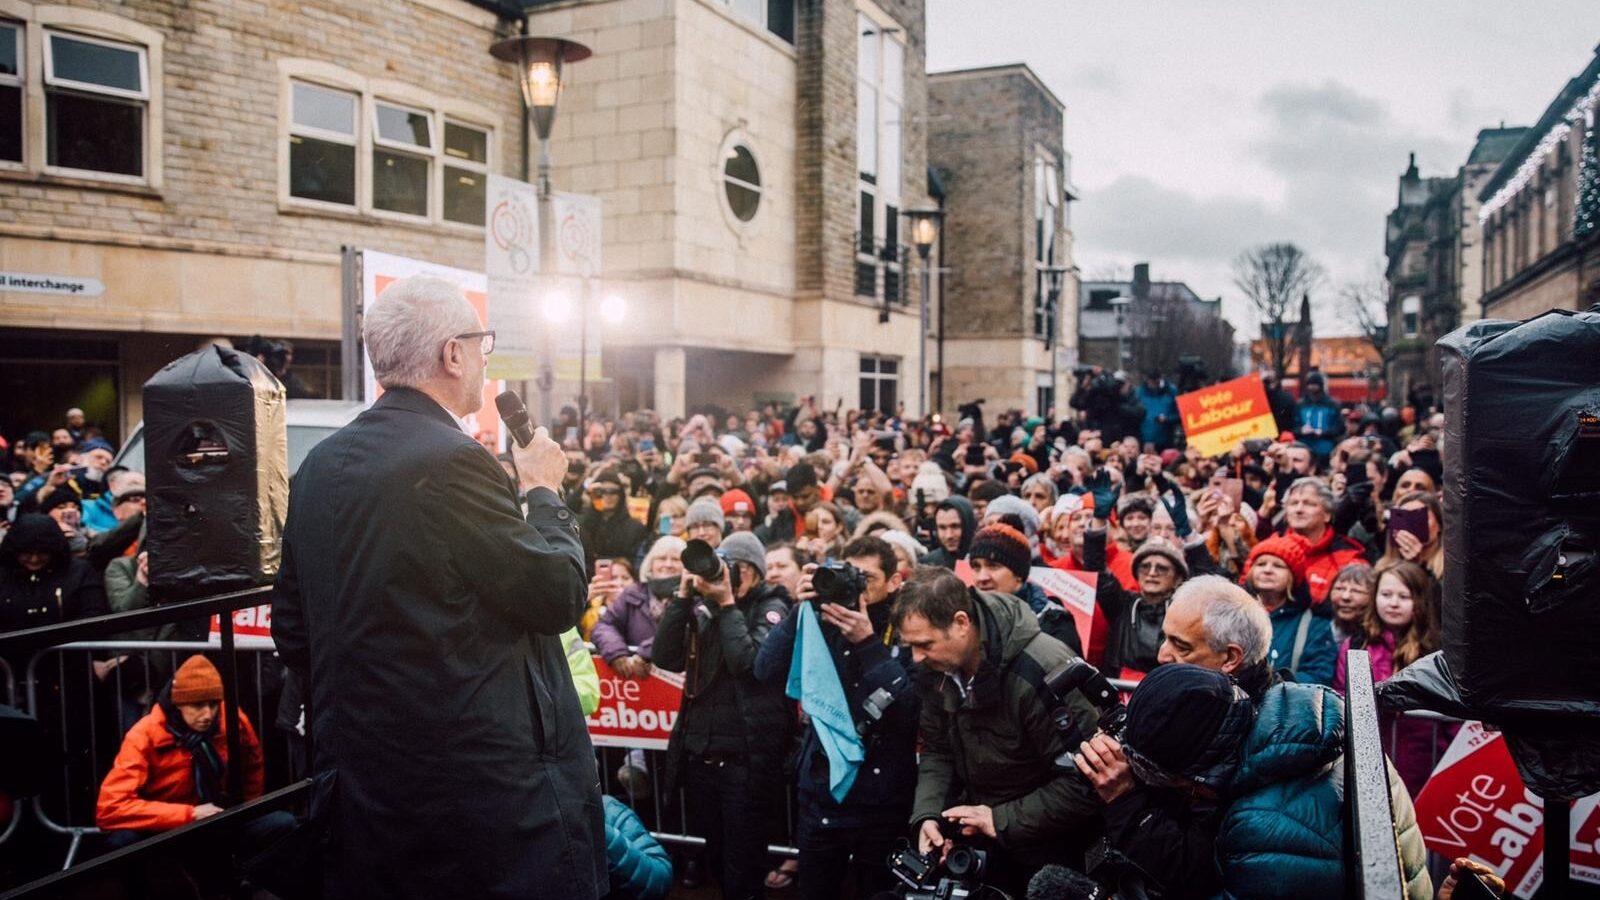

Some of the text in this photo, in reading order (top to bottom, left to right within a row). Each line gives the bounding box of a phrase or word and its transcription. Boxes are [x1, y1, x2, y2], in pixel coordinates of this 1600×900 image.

[9, 276, 84, 292] interchange
[1199, 391, 1232, 409] Vote
[1187, 400, 1253, 430] Labour
[600, 676, 640, 701] ote
[585, 701, 679, 731] Labou
[1424, 774, 1506, 848] Vote
